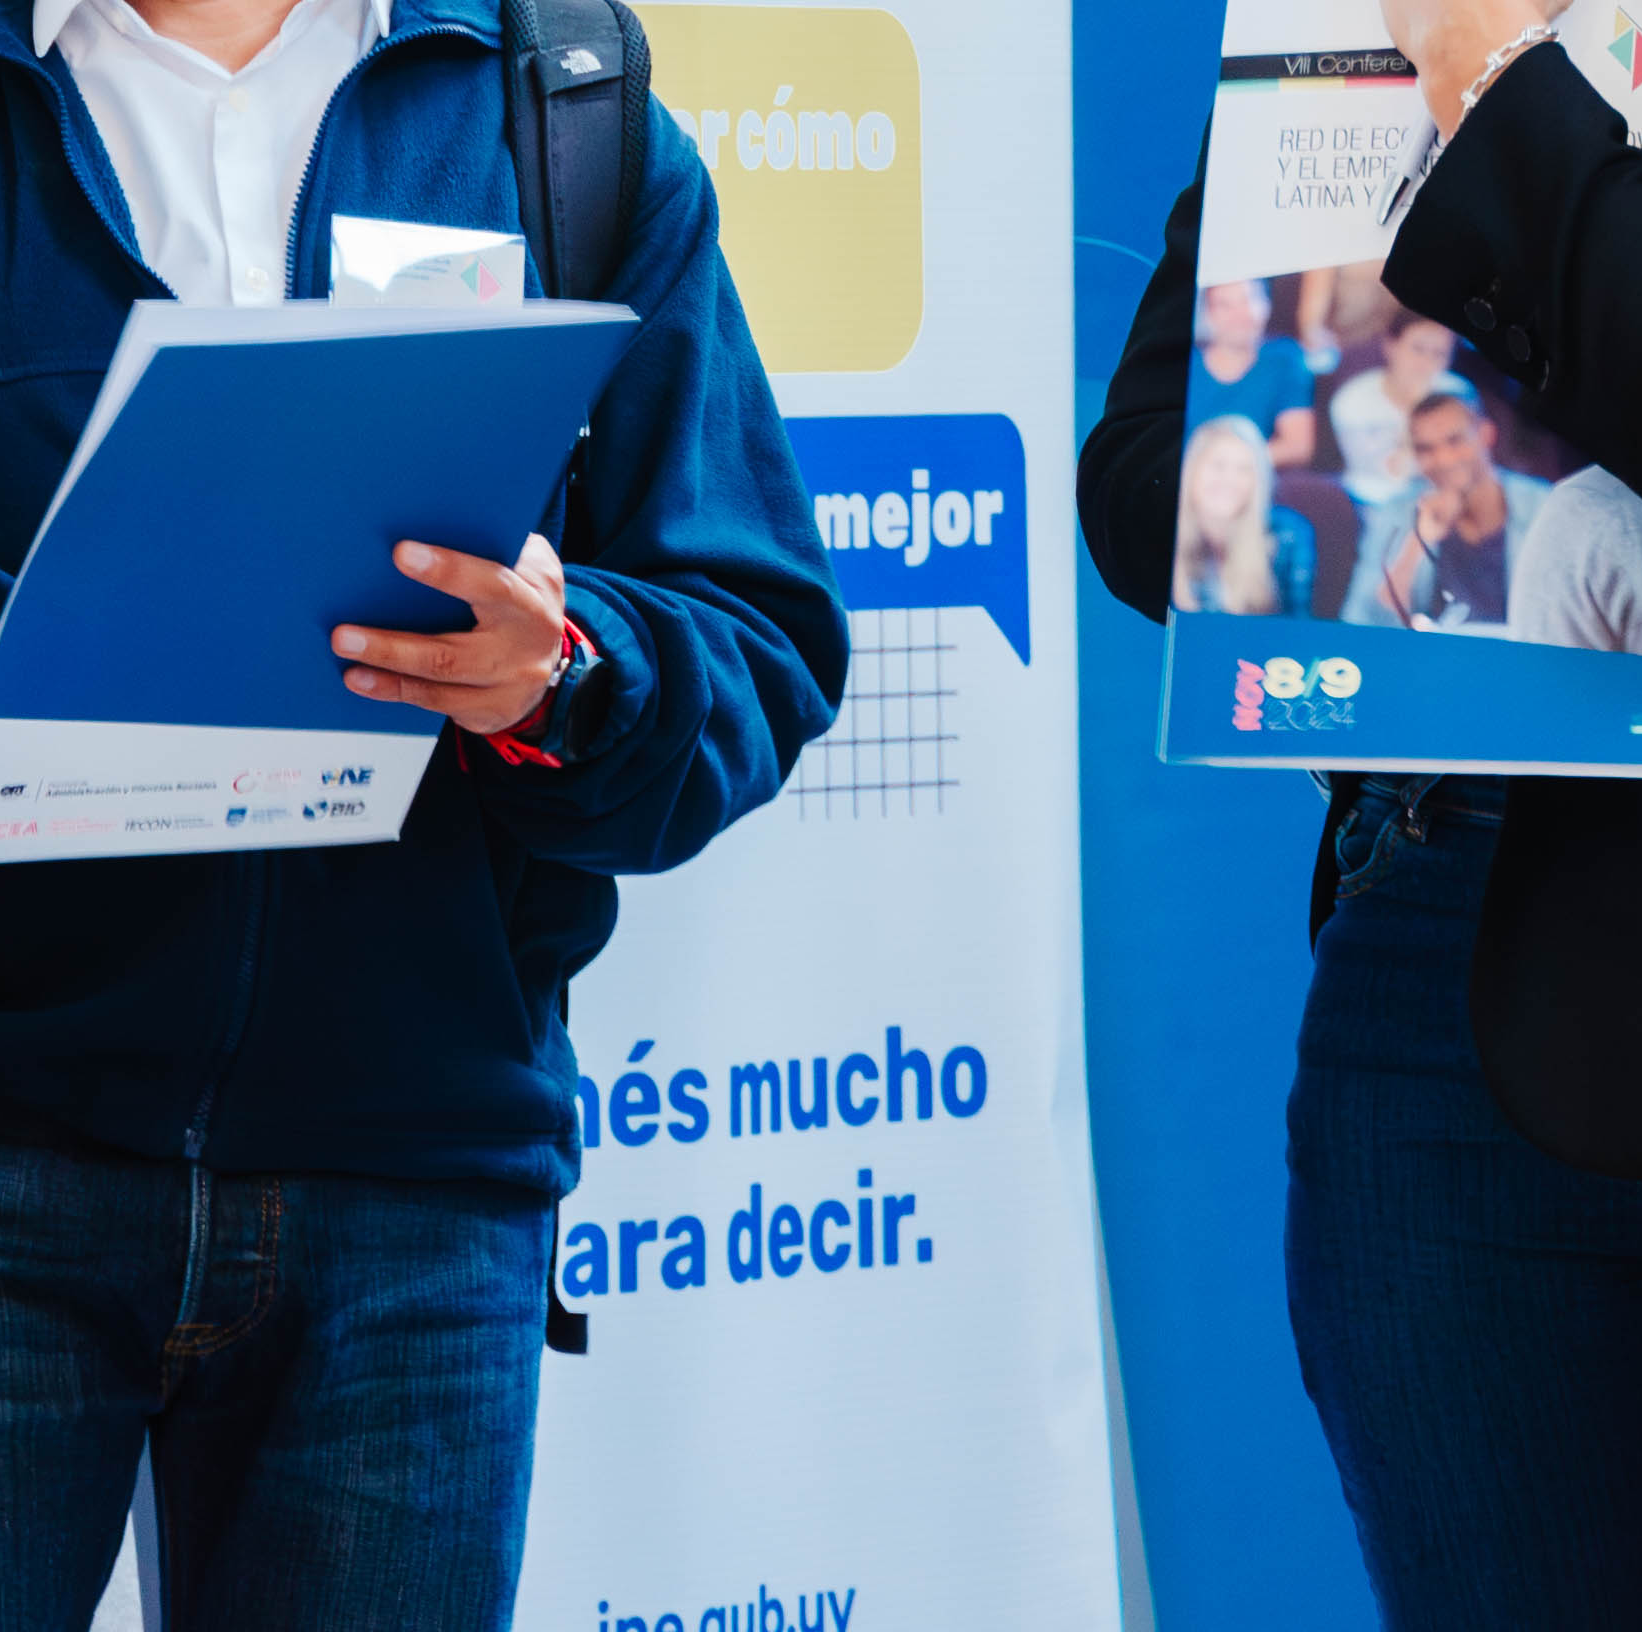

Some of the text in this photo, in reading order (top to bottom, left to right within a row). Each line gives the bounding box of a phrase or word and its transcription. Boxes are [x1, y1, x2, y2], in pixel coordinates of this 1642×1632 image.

[1285, 56, 1311, 76] VIII
[737, 85, 896, 171] cómo
[1280, 128, 1324, 152] RED
[1333, 128, 1363, 151] DE
[1277, 156, 1292, 181] Y
[1299, 156, 1325, 180] EL
[1275, 184, 1377, 209] LATINA Y
[814, 468, 1004, 568] mejor
[1262, 656, 1362, 699] 8/9
[730, 1025, 987, 1138] mucho
[727, 1168, 934, 1285] decir.
